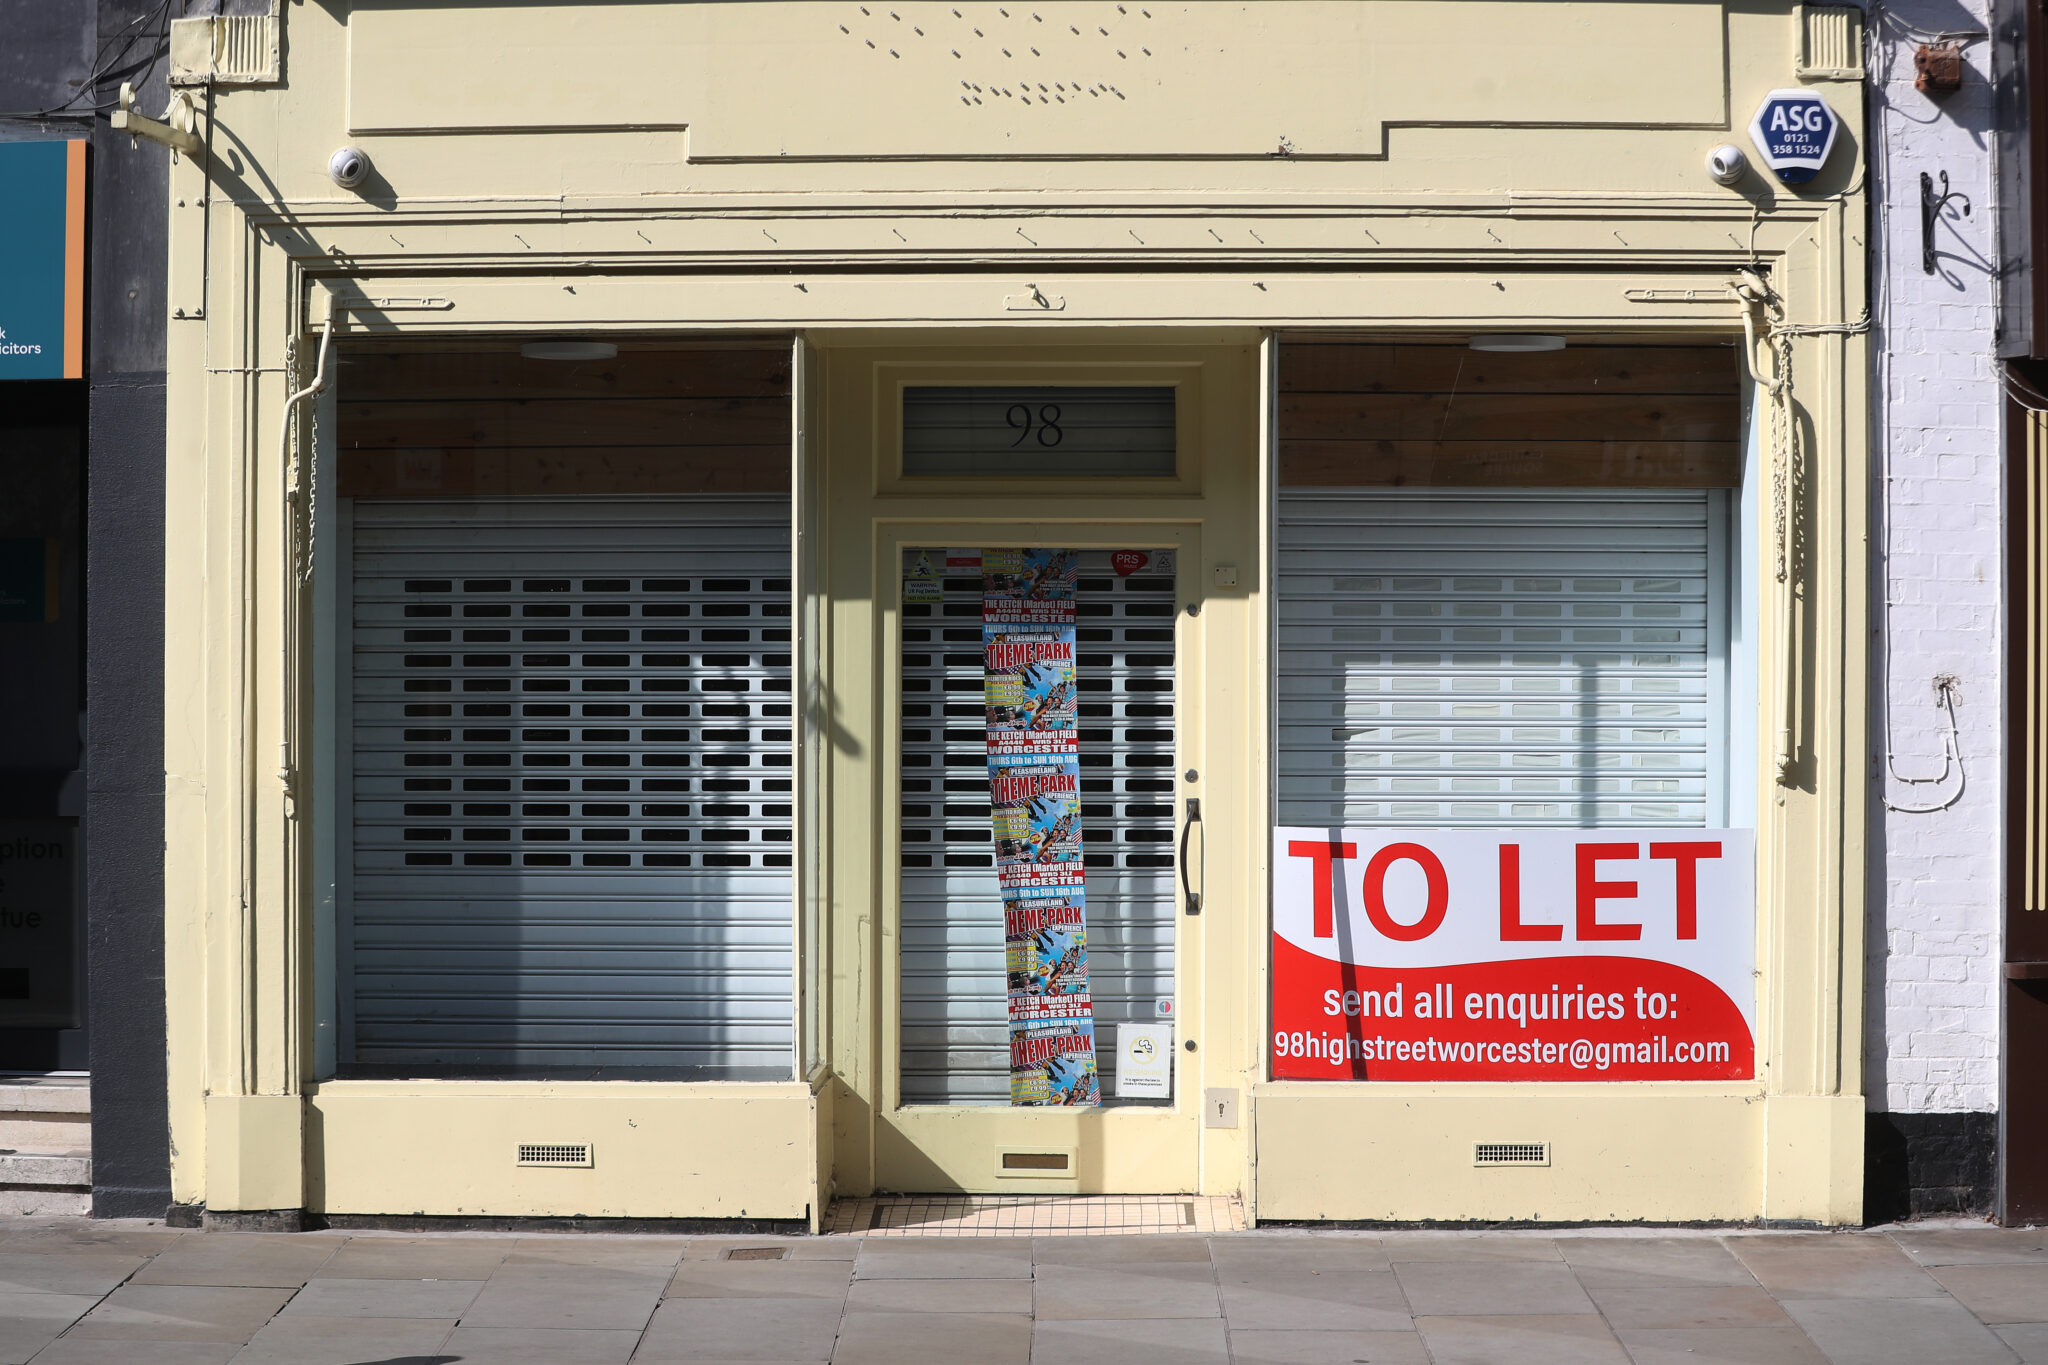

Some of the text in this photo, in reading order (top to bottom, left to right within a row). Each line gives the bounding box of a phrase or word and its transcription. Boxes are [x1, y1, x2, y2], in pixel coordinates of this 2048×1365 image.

[1770, 105, 1823, 132] ASG
[1784, 134, 1809, 142] 0121
[1772, 145, 1820, 154] 358 1524
[1004, 404, 1064, 447] 98
[1116, 554, 1139, 564] PRS
[985, 600, 1075, 609] THE KETCH (Market) FIELD
[985, 614, 1075, 622] WORCESTER
[987, 643, 1072, 670] THEME PARK
[1040, 660, 1071, 668] EXPERIENCE
[988, 730, 1077, 740] THE KETCH (Market) FIELD
[988, 745, 1077, 754] WORCESTER
[989, 757, 1010, 765] THURS
[1011, 756, 1023, 764] 6th
[1025, 756, 1032, 764] to
[1064, 755, 1078, 763] AUG
[1010, 767, 1057, 775] PLEASURELAND
[992, 774, 1076, 803] THEME PARK
[1008, 864, 1031, 874] KETCH
[1033, 863, 1064, 872] (Market)
[1066, 862, 1083, 871] FIELD
[1056, 888, 1070, 896] 16th
[1071, 887, 1084, 895] AUG
[1288, 840, 1722, 942] TO LET
[1018, 900, 1063, 908] PLEASURELAND
[1047, 907, 1082, 926] PARK
[1017, 997, 1040, 1006] KETCH
[1042, 995, 1072, 1004] (Market)
[1074, 994, 1090, 1002] FIELD
[1323, 983, 1677, 1028] send all enquiries to:
[1027, 1028, 1072, 1038] PLEASURELAND
[1010, 1035, 1092, 1067] THEME PARK
[1275, 1030, 1730, 1070] 98highstreetworcester@gmail.com
